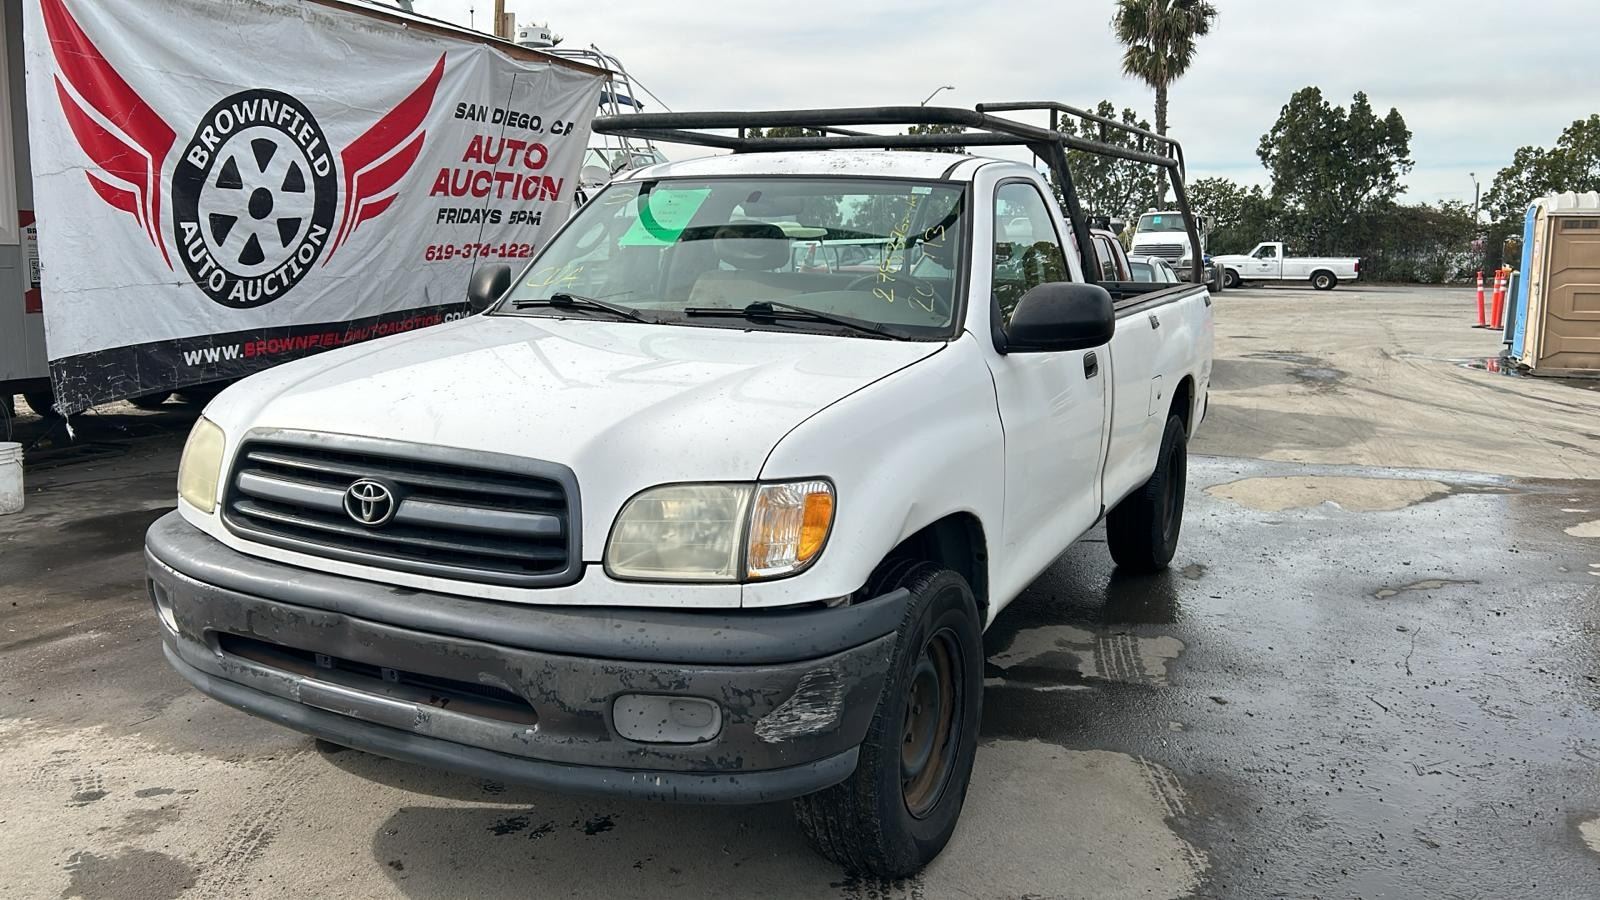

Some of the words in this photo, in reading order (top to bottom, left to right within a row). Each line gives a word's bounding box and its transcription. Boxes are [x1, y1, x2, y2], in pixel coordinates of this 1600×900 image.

[454, 102, 489, 123] SAN
[491, 108, 544, 134] DIEGO,
[187, 98, 330, 177] BROWNFIELD
[462, 134, 548, 170] AUTO
[429, 167, 564, 201] AUCTION
[436, 207, 502, 225] FRIDAYS
[508, 210, 542, 226] 5PM
[179, 221, 226, 292] AUTO
[227, 223, 327, 302] AUCTION
